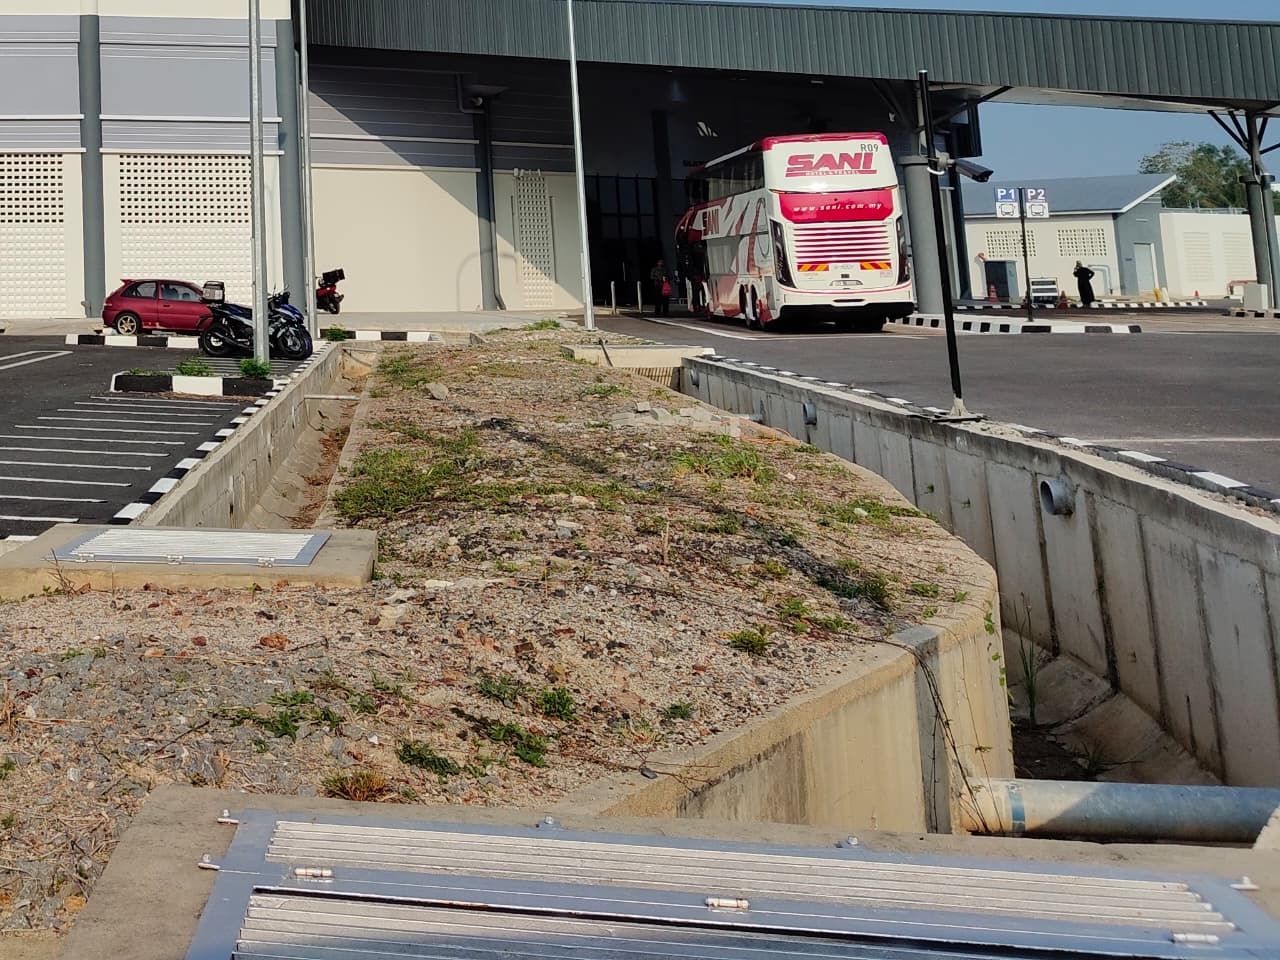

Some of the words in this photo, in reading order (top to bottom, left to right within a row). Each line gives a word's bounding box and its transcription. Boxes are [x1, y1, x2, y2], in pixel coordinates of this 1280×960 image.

[860, 143, 879, 152] R09
[786, 152, 874, 173] SANI
[1027, 188, 1046, 200] P2
[793, 203, 882, 212] www.sani.com.my
